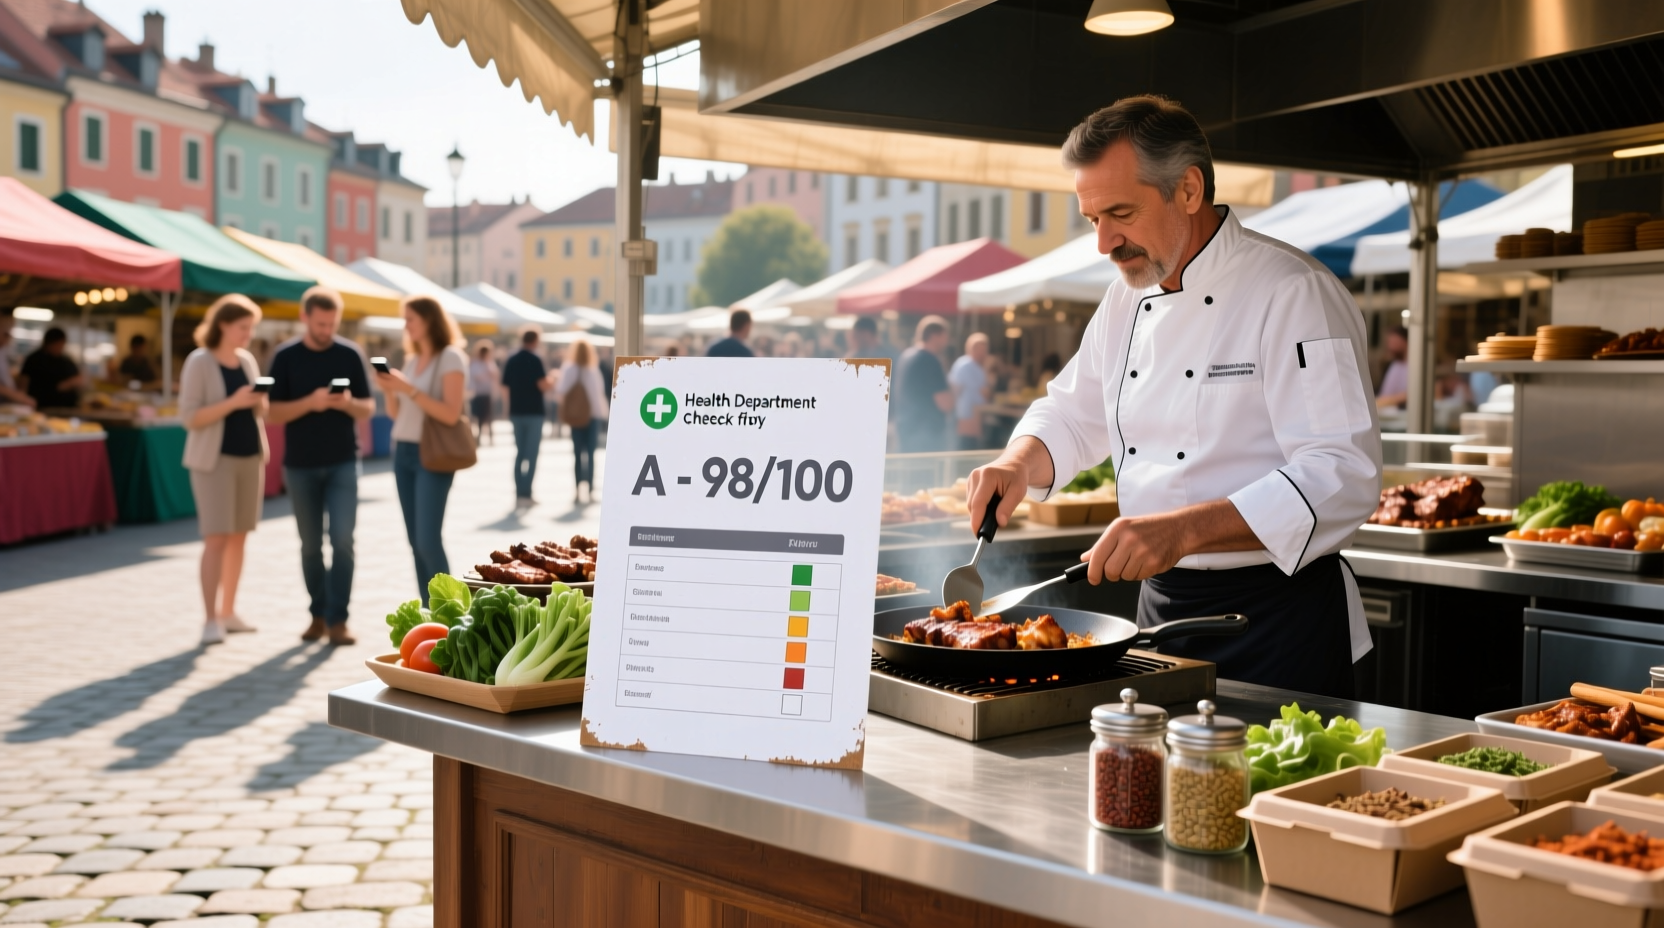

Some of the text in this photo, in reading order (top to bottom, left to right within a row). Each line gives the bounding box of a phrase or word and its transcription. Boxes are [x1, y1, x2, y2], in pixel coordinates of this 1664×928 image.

[685, 393, 816, 411] Health Department
[683, 410, 734, 426] Cheeck
[631, 454, 666, 496] A
[702, 456, 853, 504] 98/100
